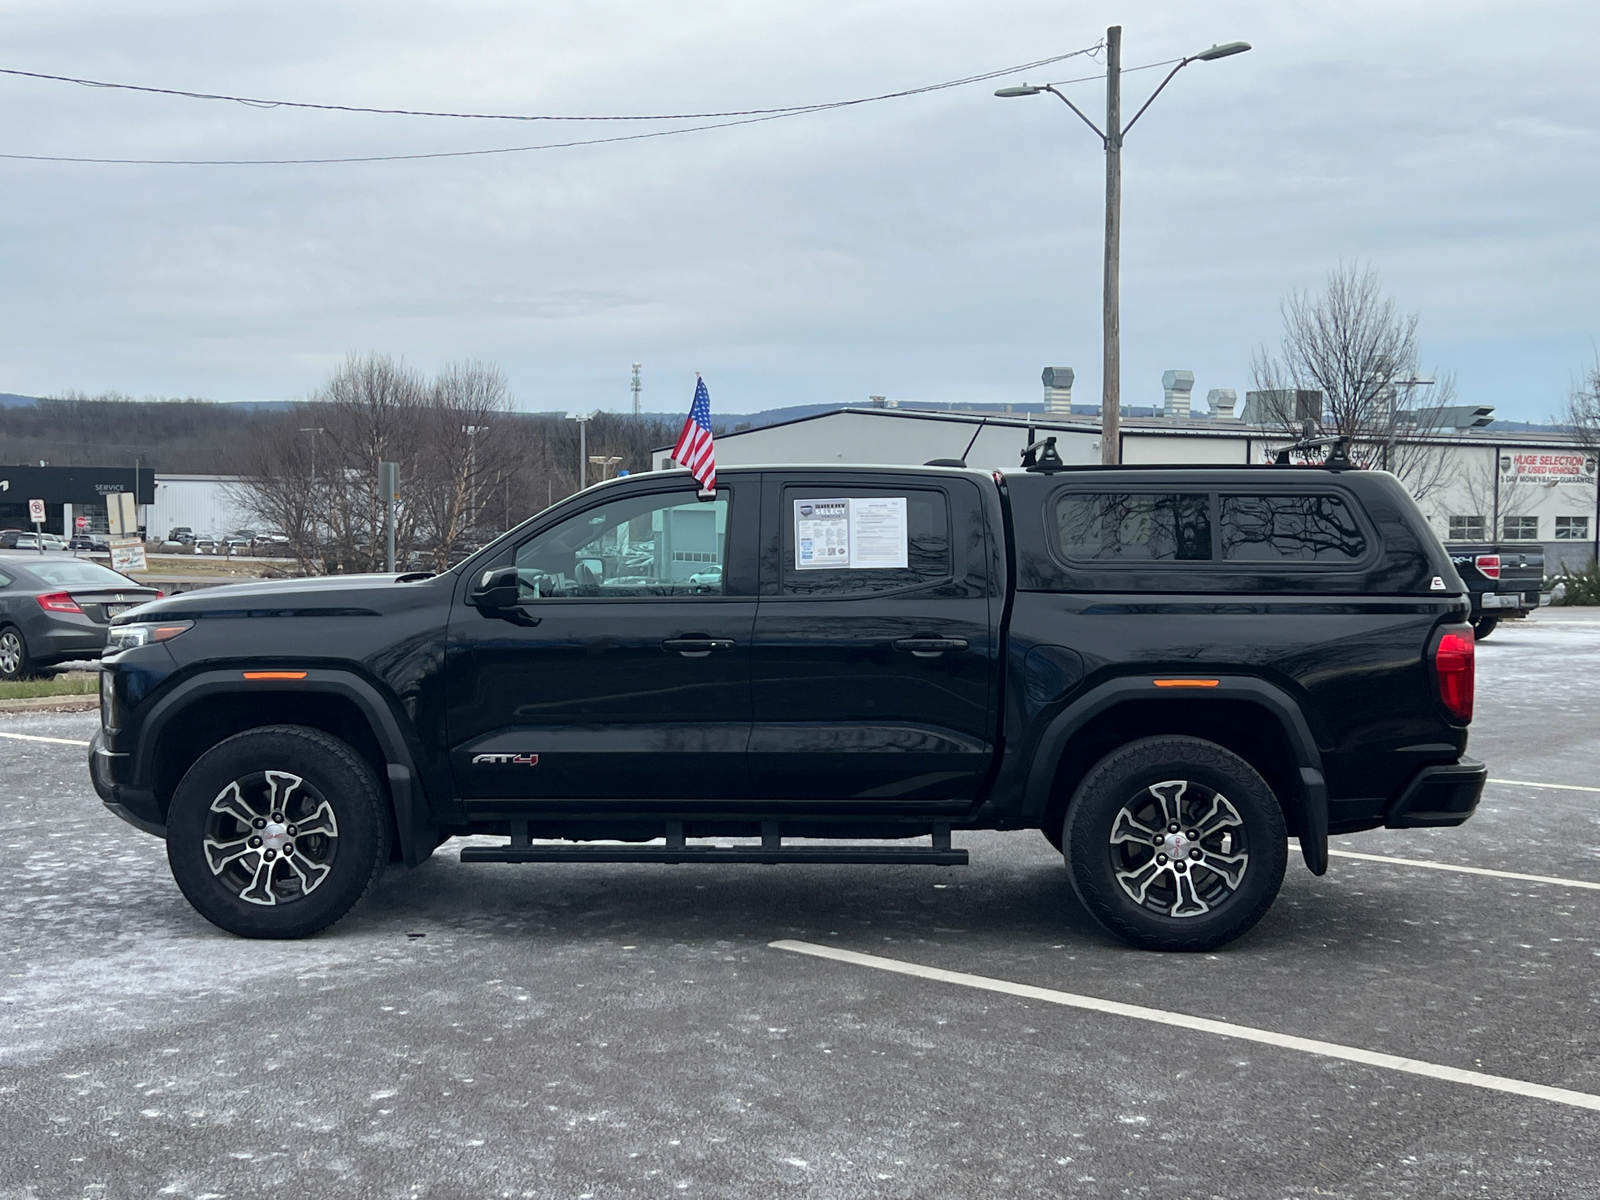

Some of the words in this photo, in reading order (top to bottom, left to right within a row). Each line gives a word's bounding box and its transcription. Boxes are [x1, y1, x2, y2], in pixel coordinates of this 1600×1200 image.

[1513, 455, 1538, 465] HUGE
[1539, 455, 1584, 466] SELECTION
[1517, 466, 1528, 474] OF
[1528, 466, 1547, 474] USED
[1548, 466, 1580, 475] VEHICLES
[472, 753, 539, 767] AT4
